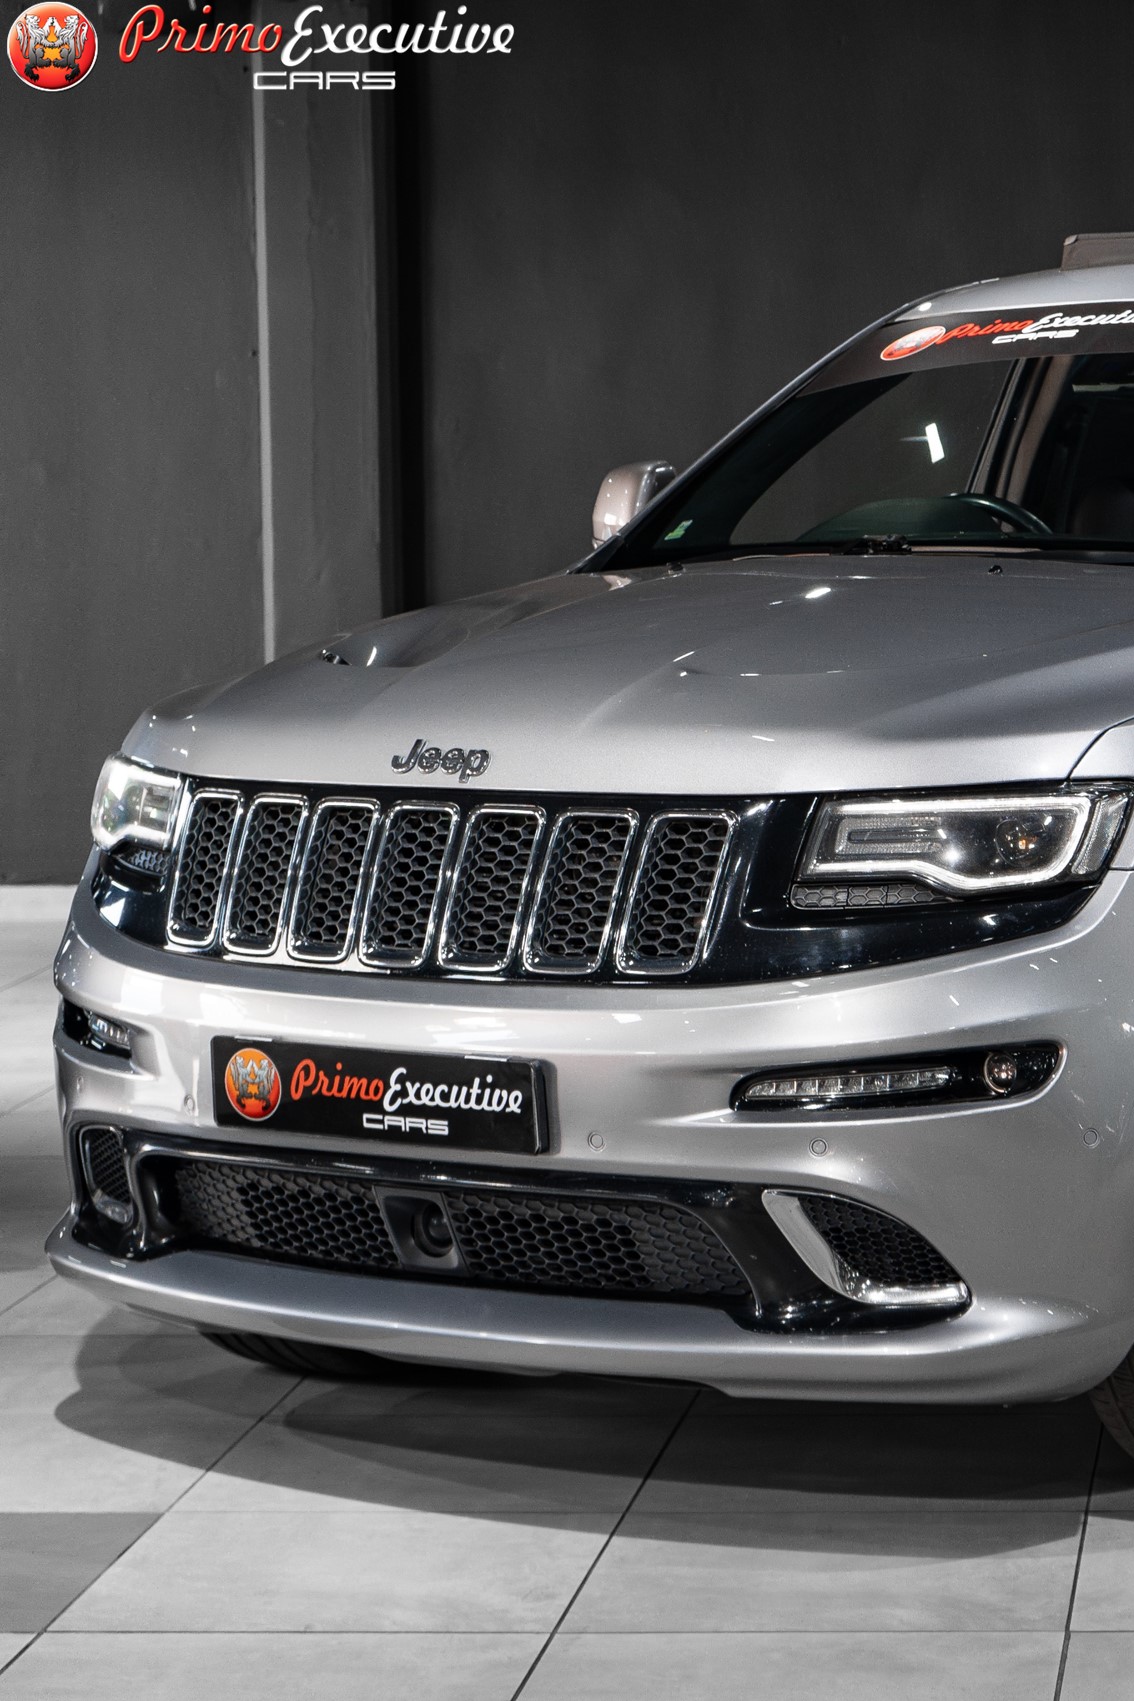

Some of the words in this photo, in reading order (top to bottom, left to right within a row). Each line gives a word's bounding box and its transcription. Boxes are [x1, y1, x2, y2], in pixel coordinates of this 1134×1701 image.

[991, 329, 1079, 344] CARS
[391, 738, 492, 783] Jeep
[362, 1112, 449, 1136] CARS
